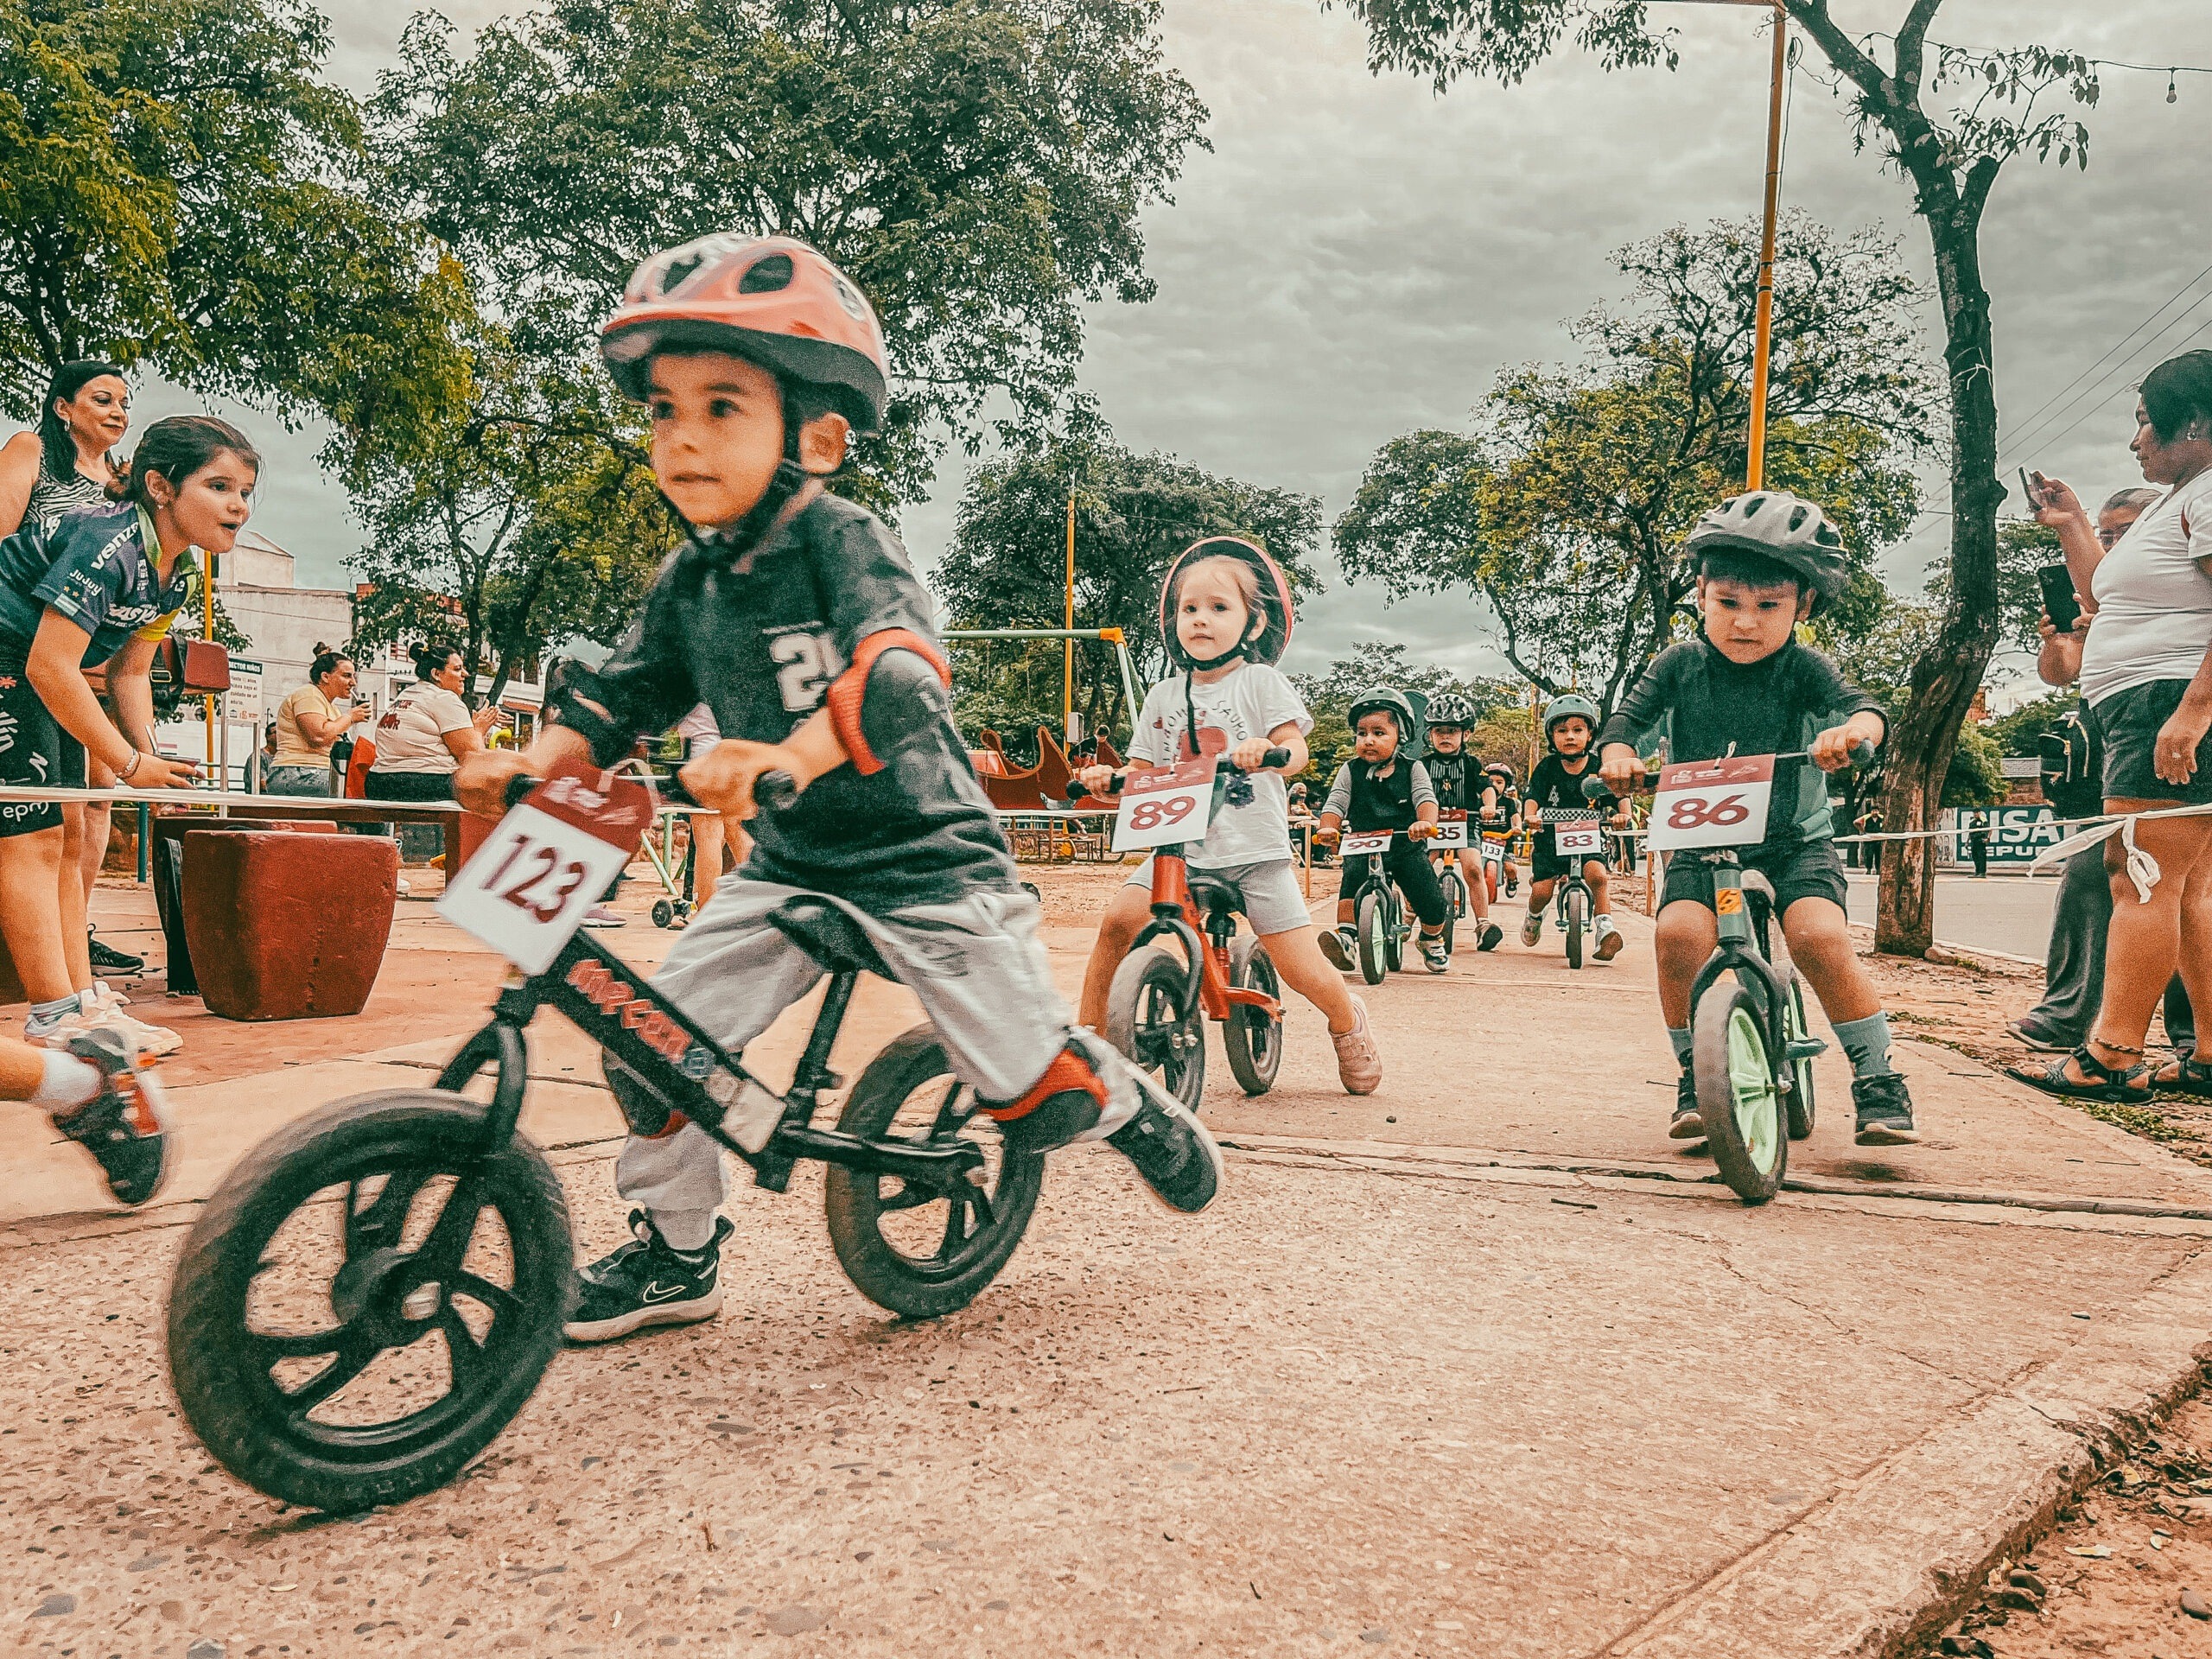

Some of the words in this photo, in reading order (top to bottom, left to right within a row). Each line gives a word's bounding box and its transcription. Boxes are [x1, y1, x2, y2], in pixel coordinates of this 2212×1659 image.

[3, 801, 49, 823] epm
[1130, 796, 1196, 830] 89
[1668, 793, 1750, 830] 86
[1347, 839, 1383, 850] 90
[1484, 845, 1501, 856] 133
[1562, 835, 1593, 848] 83
[479, 834, 586, 923] 123
